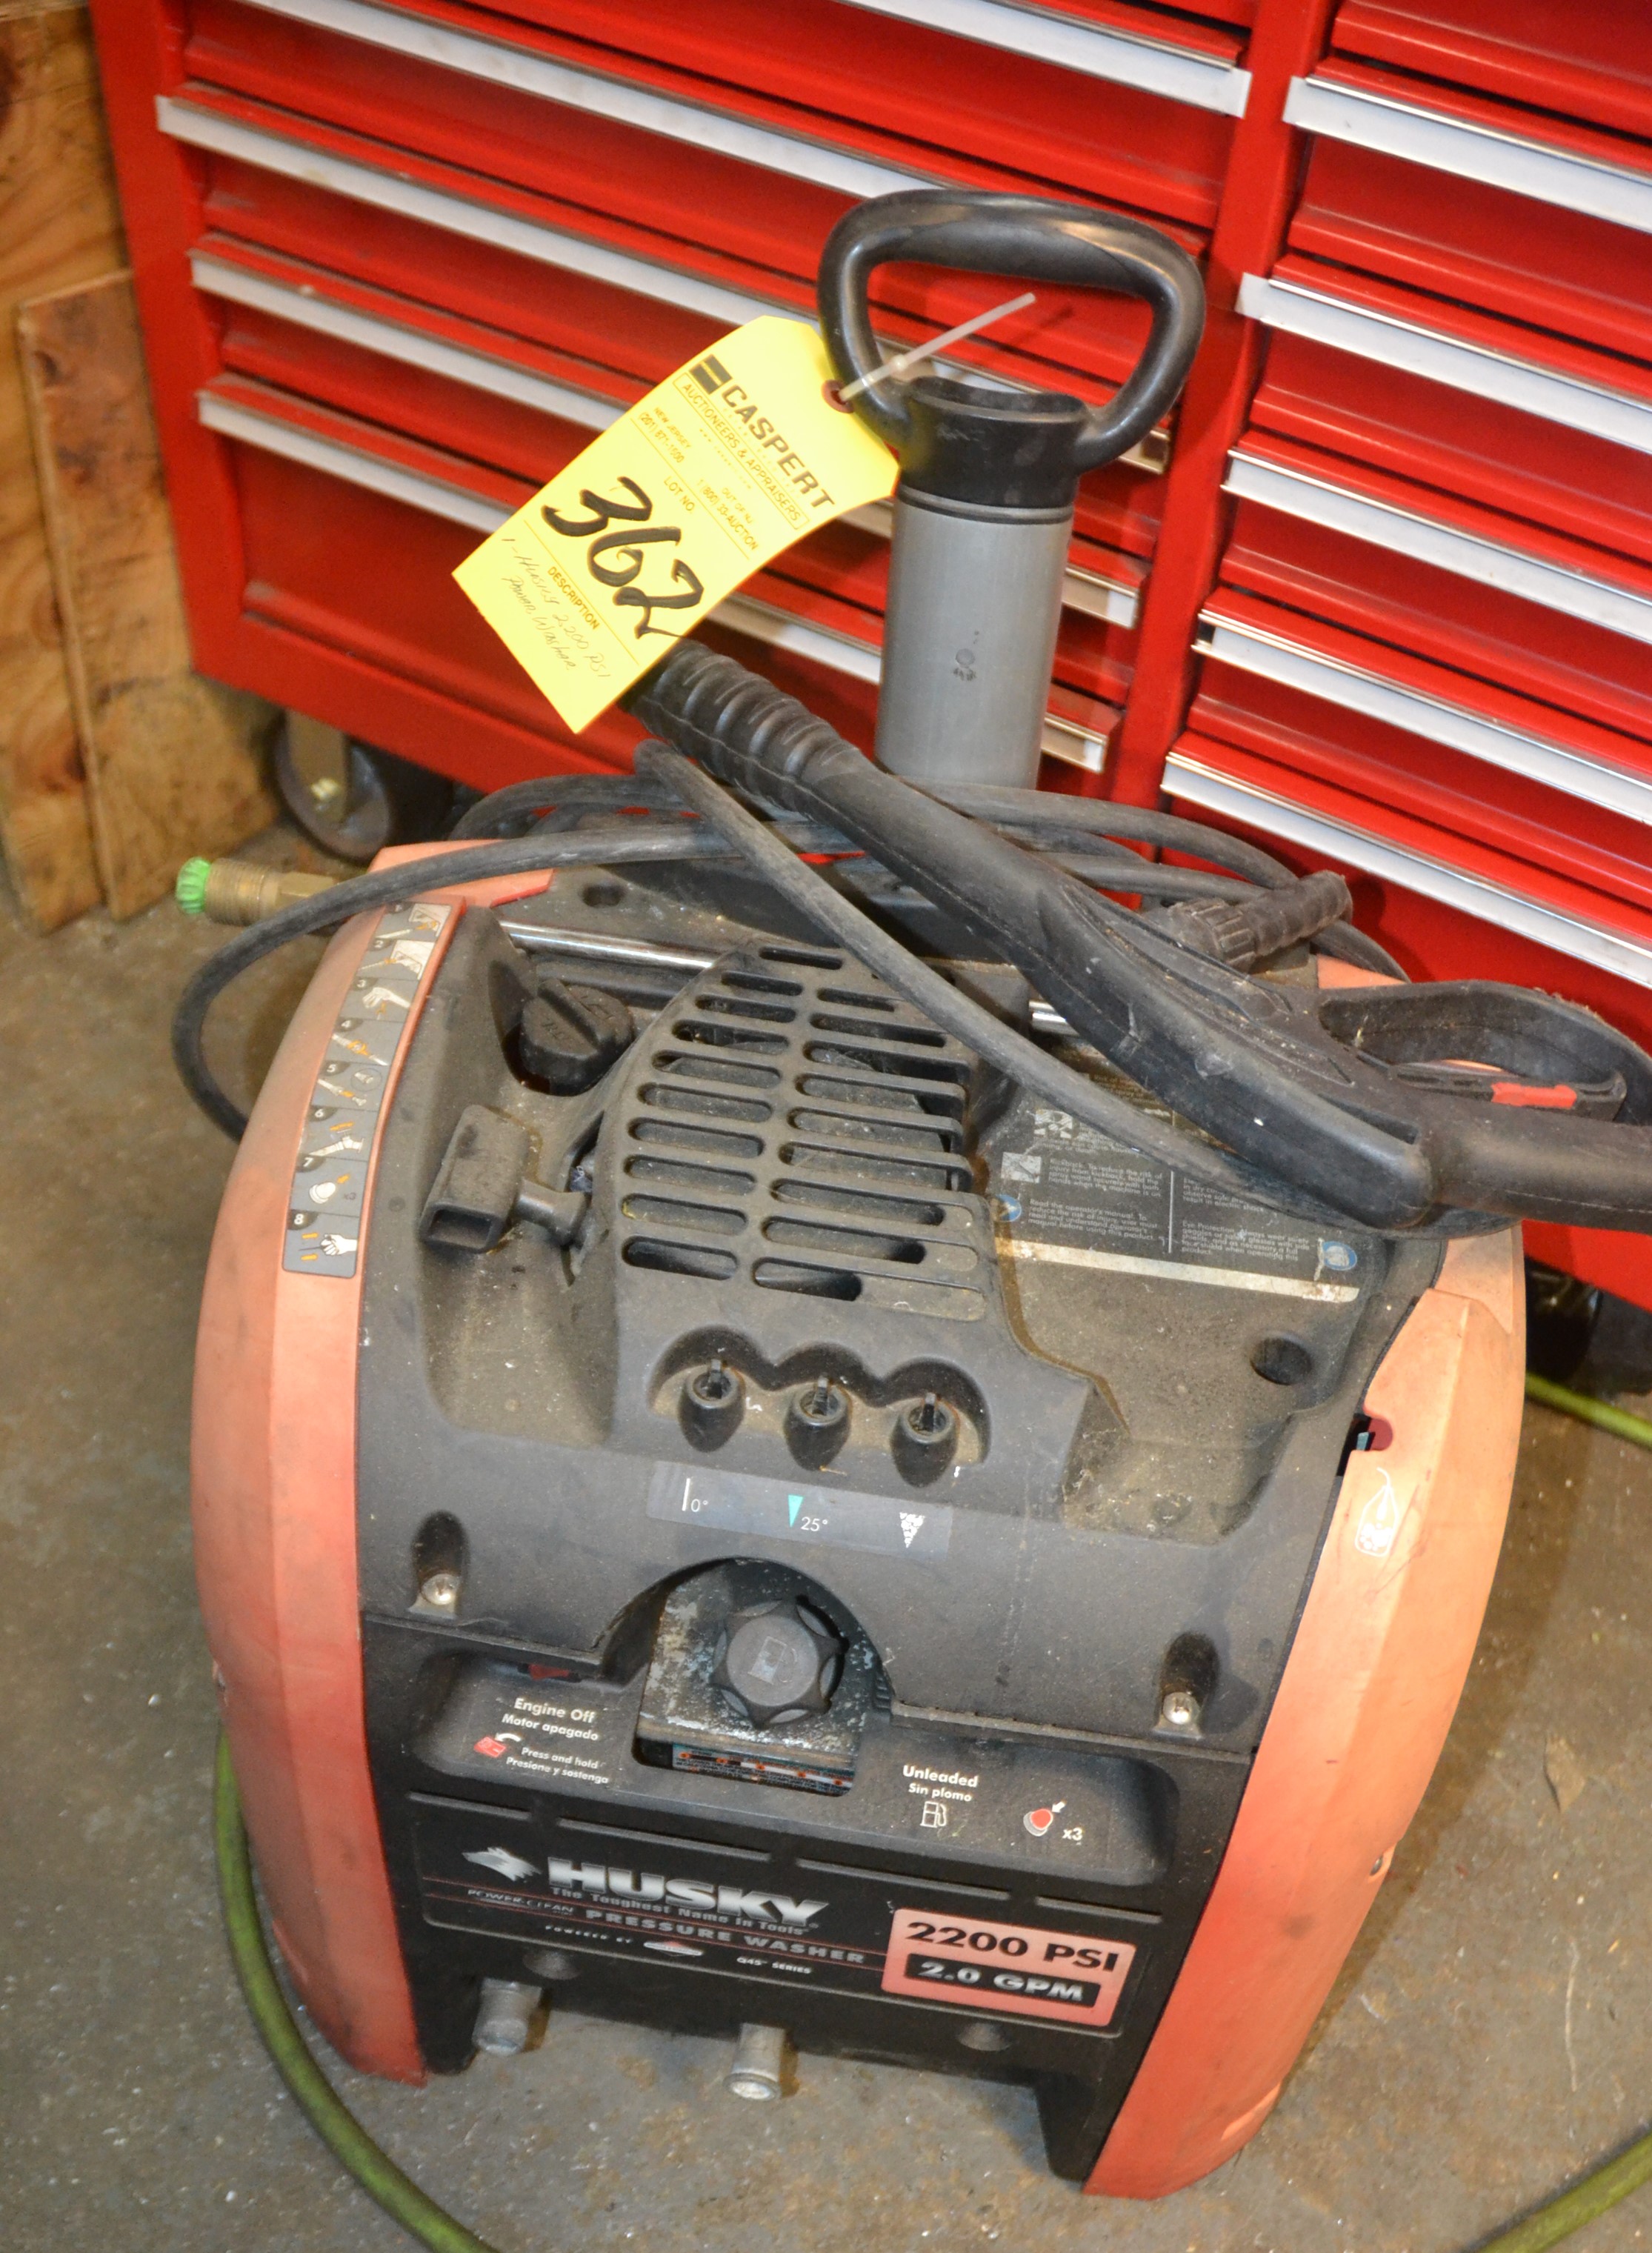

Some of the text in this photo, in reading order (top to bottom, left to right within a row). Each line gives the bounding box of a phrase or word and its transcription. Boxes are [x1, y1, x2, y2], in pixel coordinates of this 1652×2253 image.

[653, 407, 692, 449] NEW JERSEY
[682, 382, 740, 449] AUCTIONEERS
[737, 448, 747, 459] &
[746, 459, 801, 522] APPRAISERS
[722, 385, 835, 507] CASPERT
[664, 476, 683, 496] LOT
[717, 503, 759, 551] 33-AUCTION
[541, 476, 705, 640] 362
[547, 566, 601, 630] DESCRIPTION
[374, 940, 384, 948] 2
[357, 979, 366, 988] 3
[341, 1019, 351, 1028] 4
[327, 1065, 336, 1073] 5
[315, 1109, 324, 1118] 6
[303, 1157, 313, 1168] 7
[1030, 1198, 1050, 1207] Read
[293, 1214, 304, 1225] 8
[800, 1517, 828, 1532] 25°
[513, 1697, 597, 1723] Engine Off
[502, 1714, 599, 1741] Motor apagado
[521, 1747, 599, 1769] Press and hold
[506, 1757, 610, 1785] Presione y sostenga
[902, 1764, 979, 1788] Unleaded
[908, 1783, 973, 1802] Sin plomo
[1062, 1827, 1083, 1841] x3
[548, 1857, 829, 1926] HUSKY
[551, 1887, 583, 1900] The
[590, 1893, 671, 1914] Toughest
[678, 1908, 729, 1924] Name
[585, 1909, 865, 1963] PRESSURE WASHER
[905, 1921, 1119, 1972] 2200 PSI
[772, 1962, 813, 1974] SERIES
[917, 1961, 1085, 2001] 2.0 GPM
